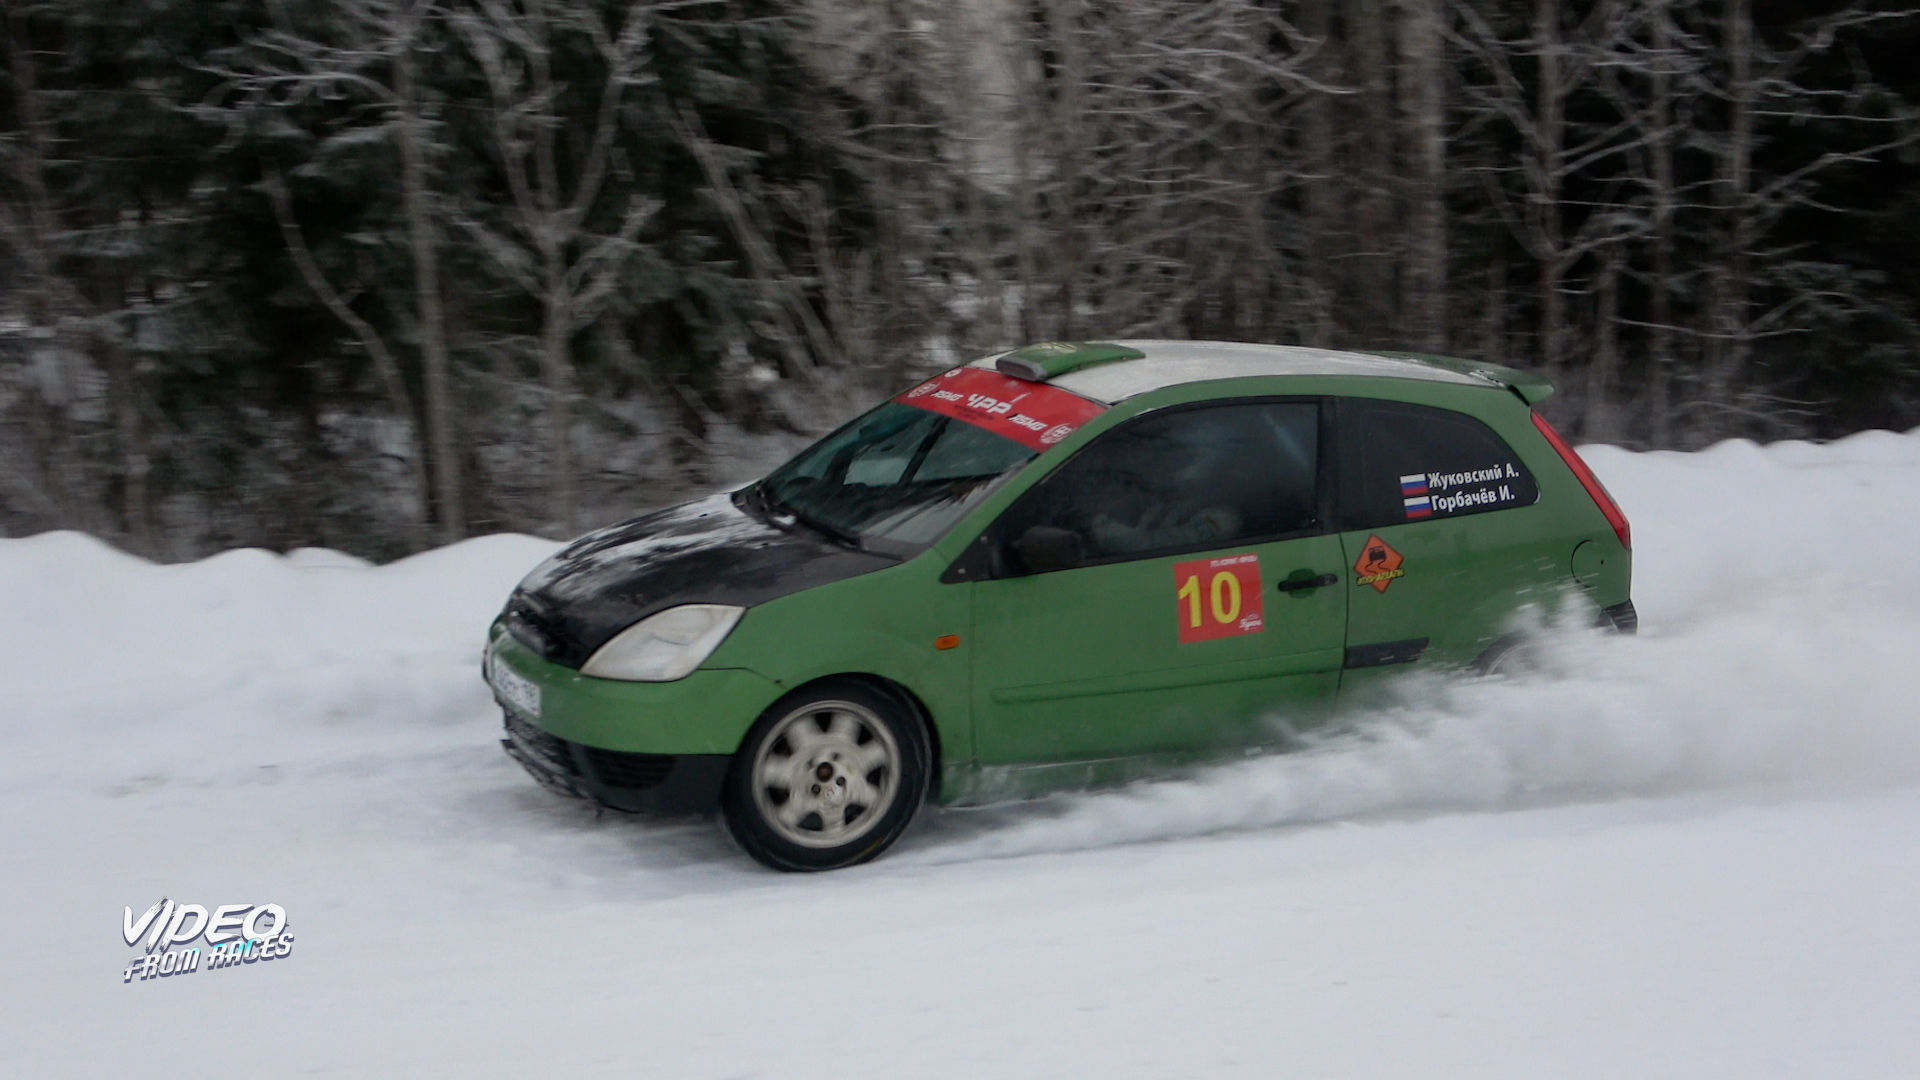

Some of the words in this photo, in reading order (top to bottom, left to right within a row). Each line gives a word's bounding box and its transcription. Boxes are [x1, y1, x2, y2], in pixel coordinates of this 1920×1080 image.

[1427, 464, 1502, 490] Жуковский
[1506, 462, 1519, 478] А.
[1431, 488, 1497, 512] Горбачёв
[1499, 485, 1515, 501] И.
[1178, 571, 1241, 628] 10
